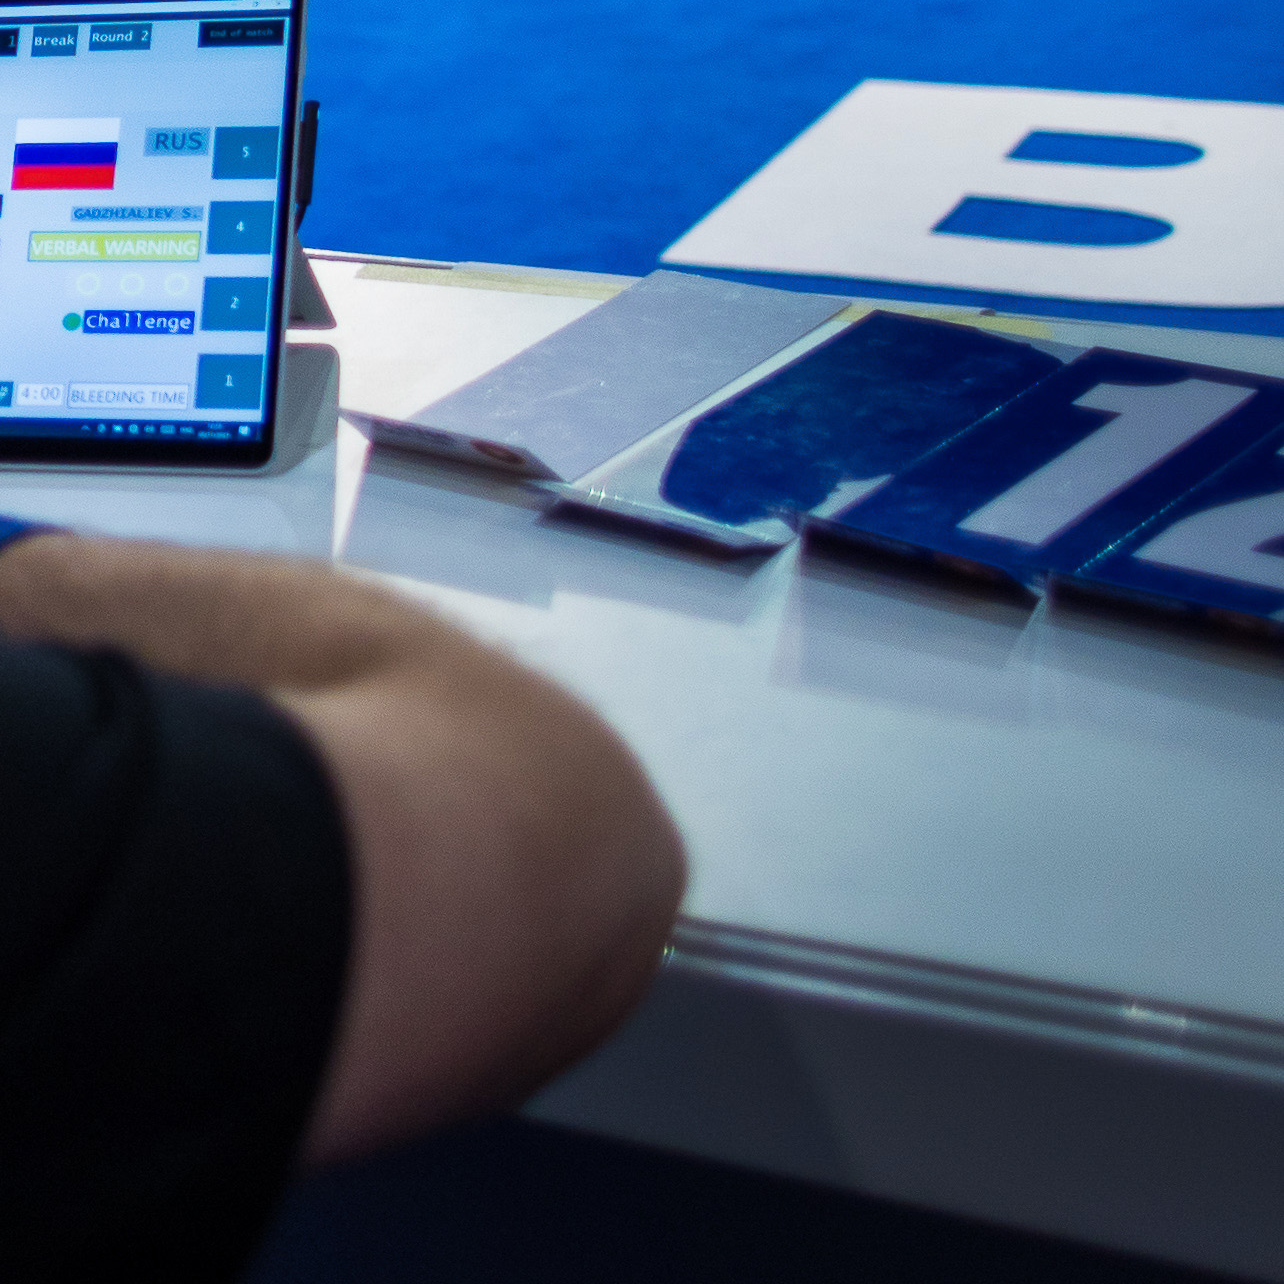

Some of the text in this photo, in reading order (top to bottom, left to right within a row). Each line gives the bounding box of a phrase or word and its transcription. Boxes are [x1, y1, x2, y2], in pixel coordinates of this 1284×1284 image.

[8, 34, 17, 48] 1
[34, 33, 75, 46] Break
[91, 30, 149, 44] Round 2
[155, 131, 203, 150] RUS
[241, 146, 250, 158] 5
[236, 221, 244, 232] 4
[31, 239, 199, 256] VERBAL WARNING
[230, 297, 240, 309] 2
[85, 312, 192, 333] Challenge
[225, 374, 233, 387] 1
[20, 386, 60, 401] 4:00
[71, 391, 186, 405] BLEEDING TIME
